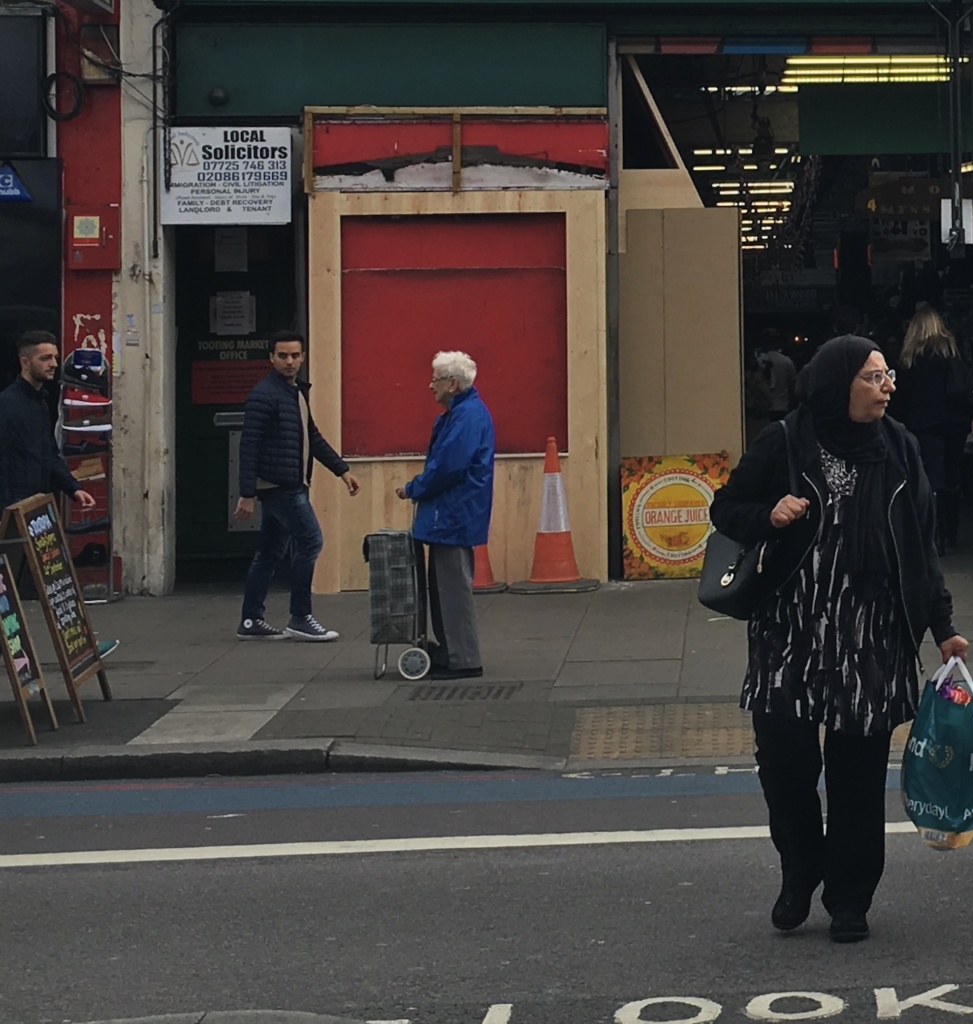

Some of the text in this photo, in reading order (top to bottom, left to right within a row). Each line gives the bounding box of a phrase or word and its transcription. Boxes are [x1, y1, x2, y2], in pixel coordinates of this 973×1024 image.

[223, 130, 266, 143] LOCAL
[202, 144, 288, 160] Solicitors
[203, 160, 287, 171] 07725 746 313
[197, 171, 288, 182] 02086179669
[197, 339, 269, 351] TOOTING MARKET
[219, 351, 248, 360] OFFICE
[644, 507, 709, 525] ORANGE JUICE
